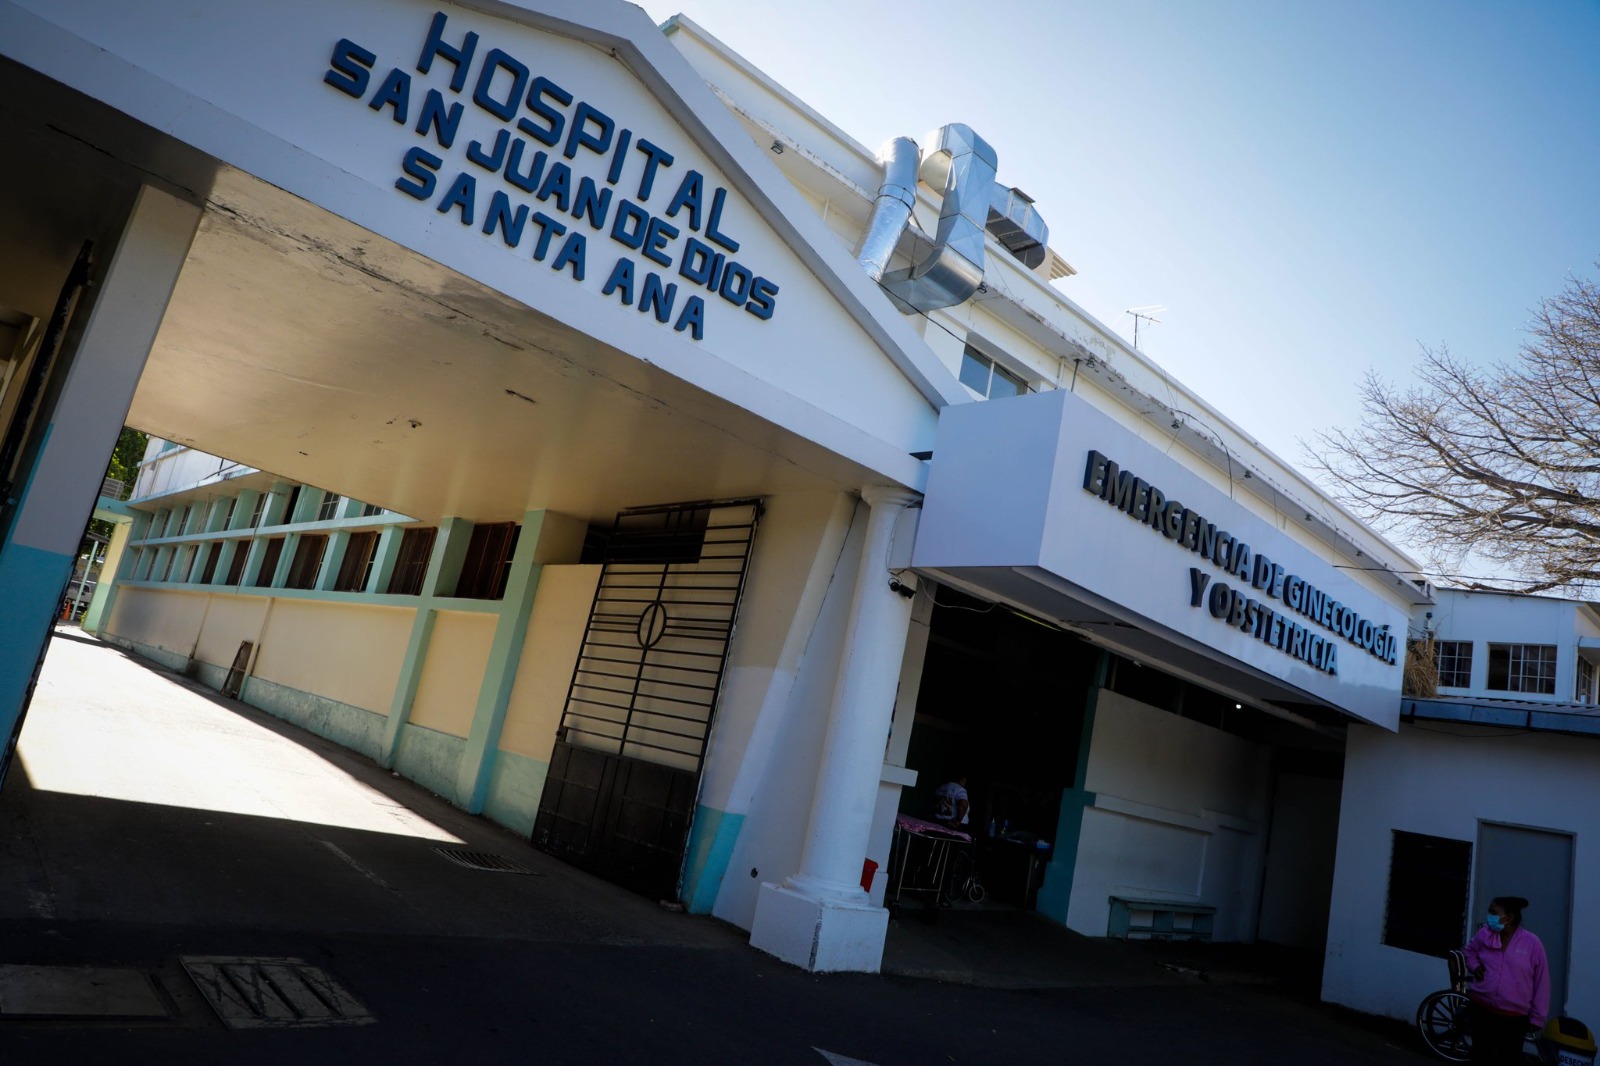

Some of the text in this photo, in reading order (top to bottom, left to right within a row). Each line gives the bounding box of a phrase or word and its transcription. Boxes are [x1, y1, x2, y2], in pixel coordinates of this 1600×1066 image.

[324, 38, 780, 320] SAN JUAN DE DIOS
[417, 12, 739, 253] HOSPITAL
[395, 146, 704, 340] SANTA ANA
[1083, 450, 1398, 666] EMERGENCIA DE GINECOLOGÍA
[1189, 567, 1338, 676] Y OBSTETRICIA
